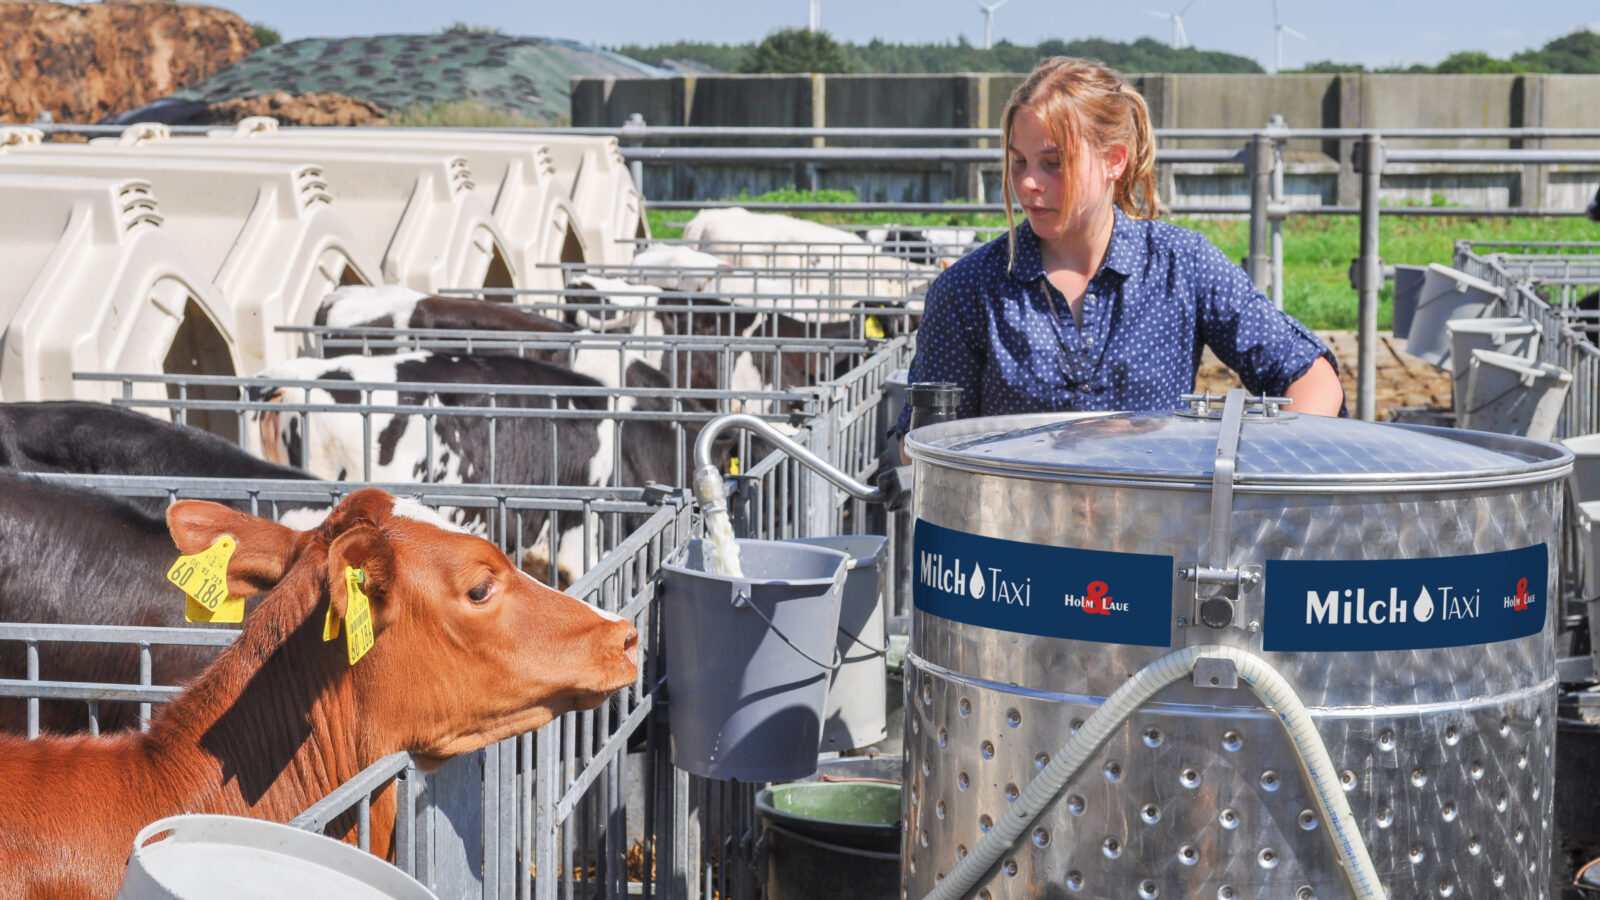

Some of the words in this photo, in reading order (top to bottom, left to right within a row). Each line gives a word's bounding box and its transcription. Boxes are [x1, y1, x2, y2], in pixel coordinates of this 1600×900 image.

[189, 558, 200, 569] DE
[920, 550, 966, 596] Milch
[170, 561, 195, 587] 60
[193, 578, 225, 609] 186
[1081, 580, 1113, 615] &
[1514, 577, 1528, 611] &
[1306, 587, 1408, 625] Milch
[351, 632, 360, 661] 60
